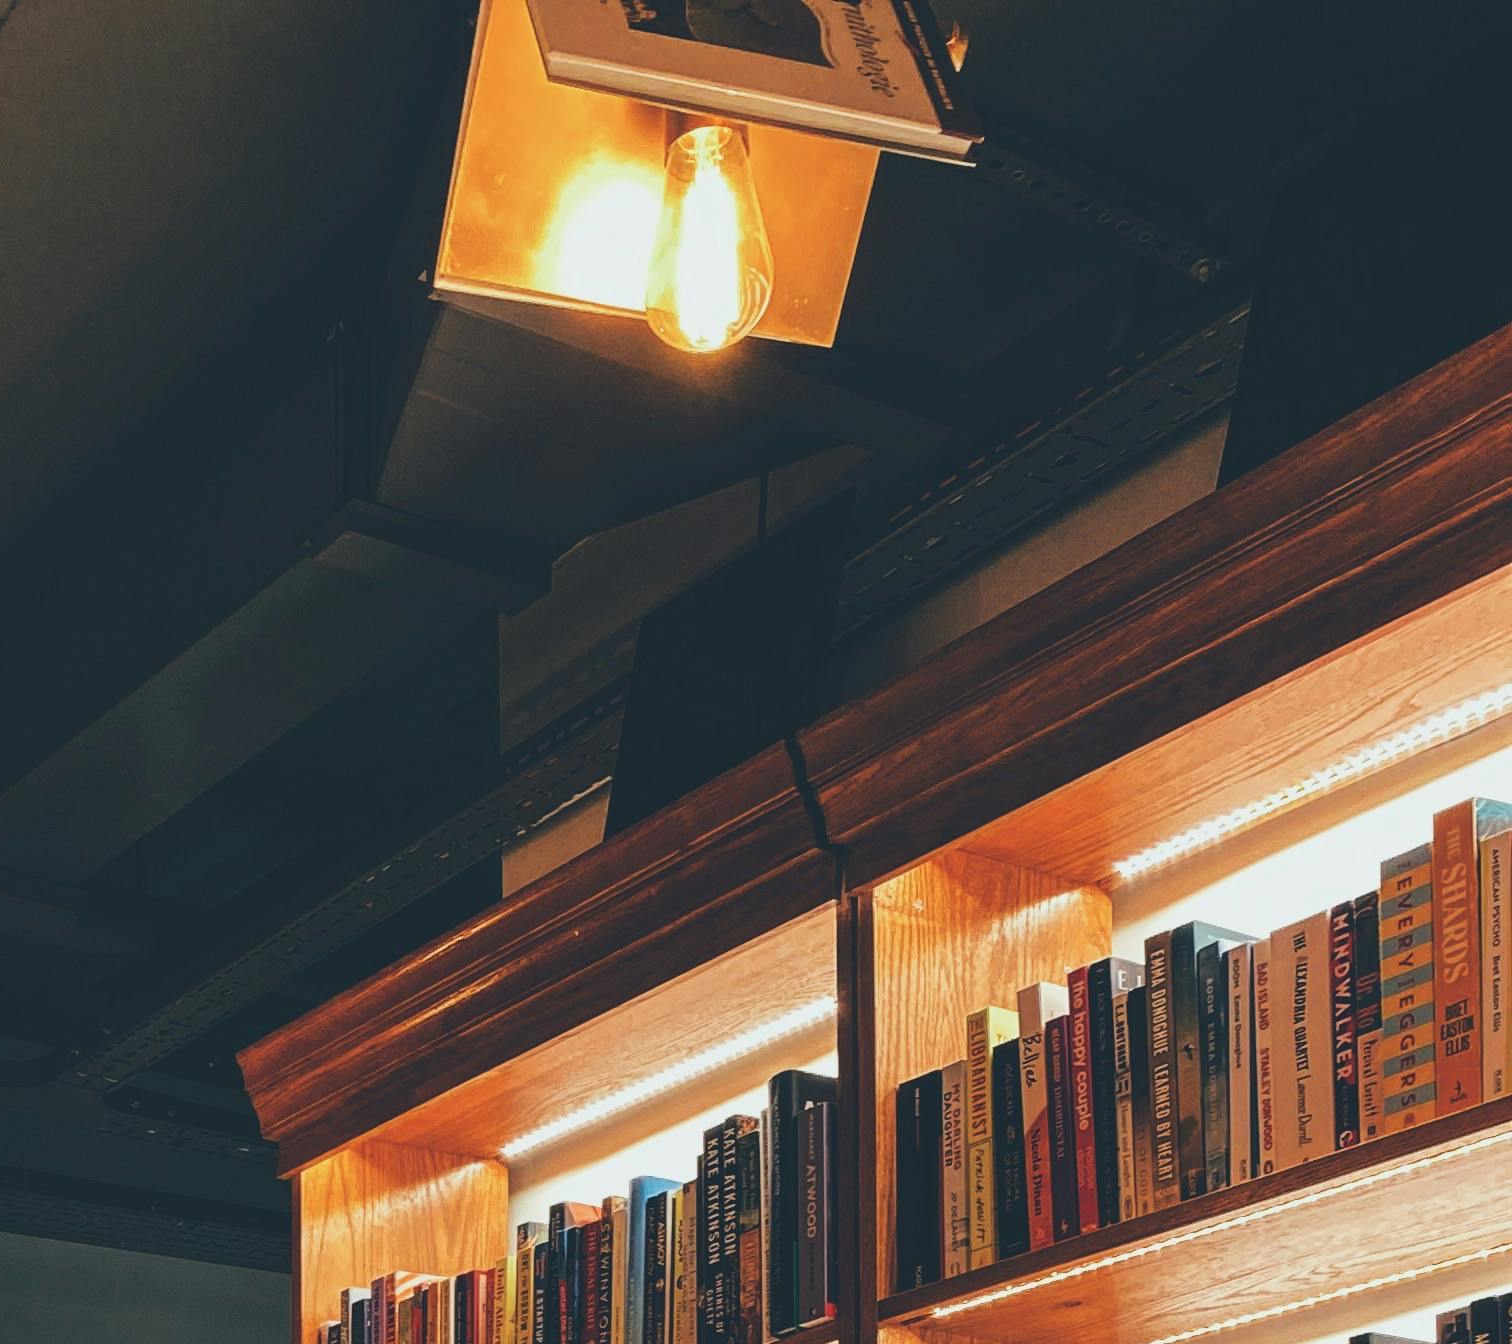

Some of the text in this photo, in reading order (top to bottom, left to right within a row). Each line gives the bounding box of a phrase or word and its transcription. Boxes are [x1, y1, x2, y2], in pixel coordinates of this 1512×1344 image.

[1441, 827, 1469, 985] THE SHARDS
[1492, 849, 1500, 906] AMERICAN
[1493, 909, 1501, 947] PSYCHO
[1257, 962, 1269, 1030] BAD ISLAND
[1332, 913, 1353, 1081] MINDWALKER
[1396, 875, 1416, 1107] EVERY EGGERS
[1492, 956, 1500, 975] Bret
[1493, 978, 1501, 1010] Easton
[1440, 1016, 1475, 1042] EASTON
[1445, 999, 1468, 1019] BRET
[1072, 980, 1089, 1131] the happy couple
[1150, 950, 1172, 1182] EMMA DONOGHUE LEARNED BY HEART
[1446, 1038, 1470, 1058] ELLIS
[708, 1137, 720, 1265] KATE ATKINSON
[724, 1127, 736, 1255] KATE ATKINSON
[805, 1165, 817, 1239] ATWOOD
